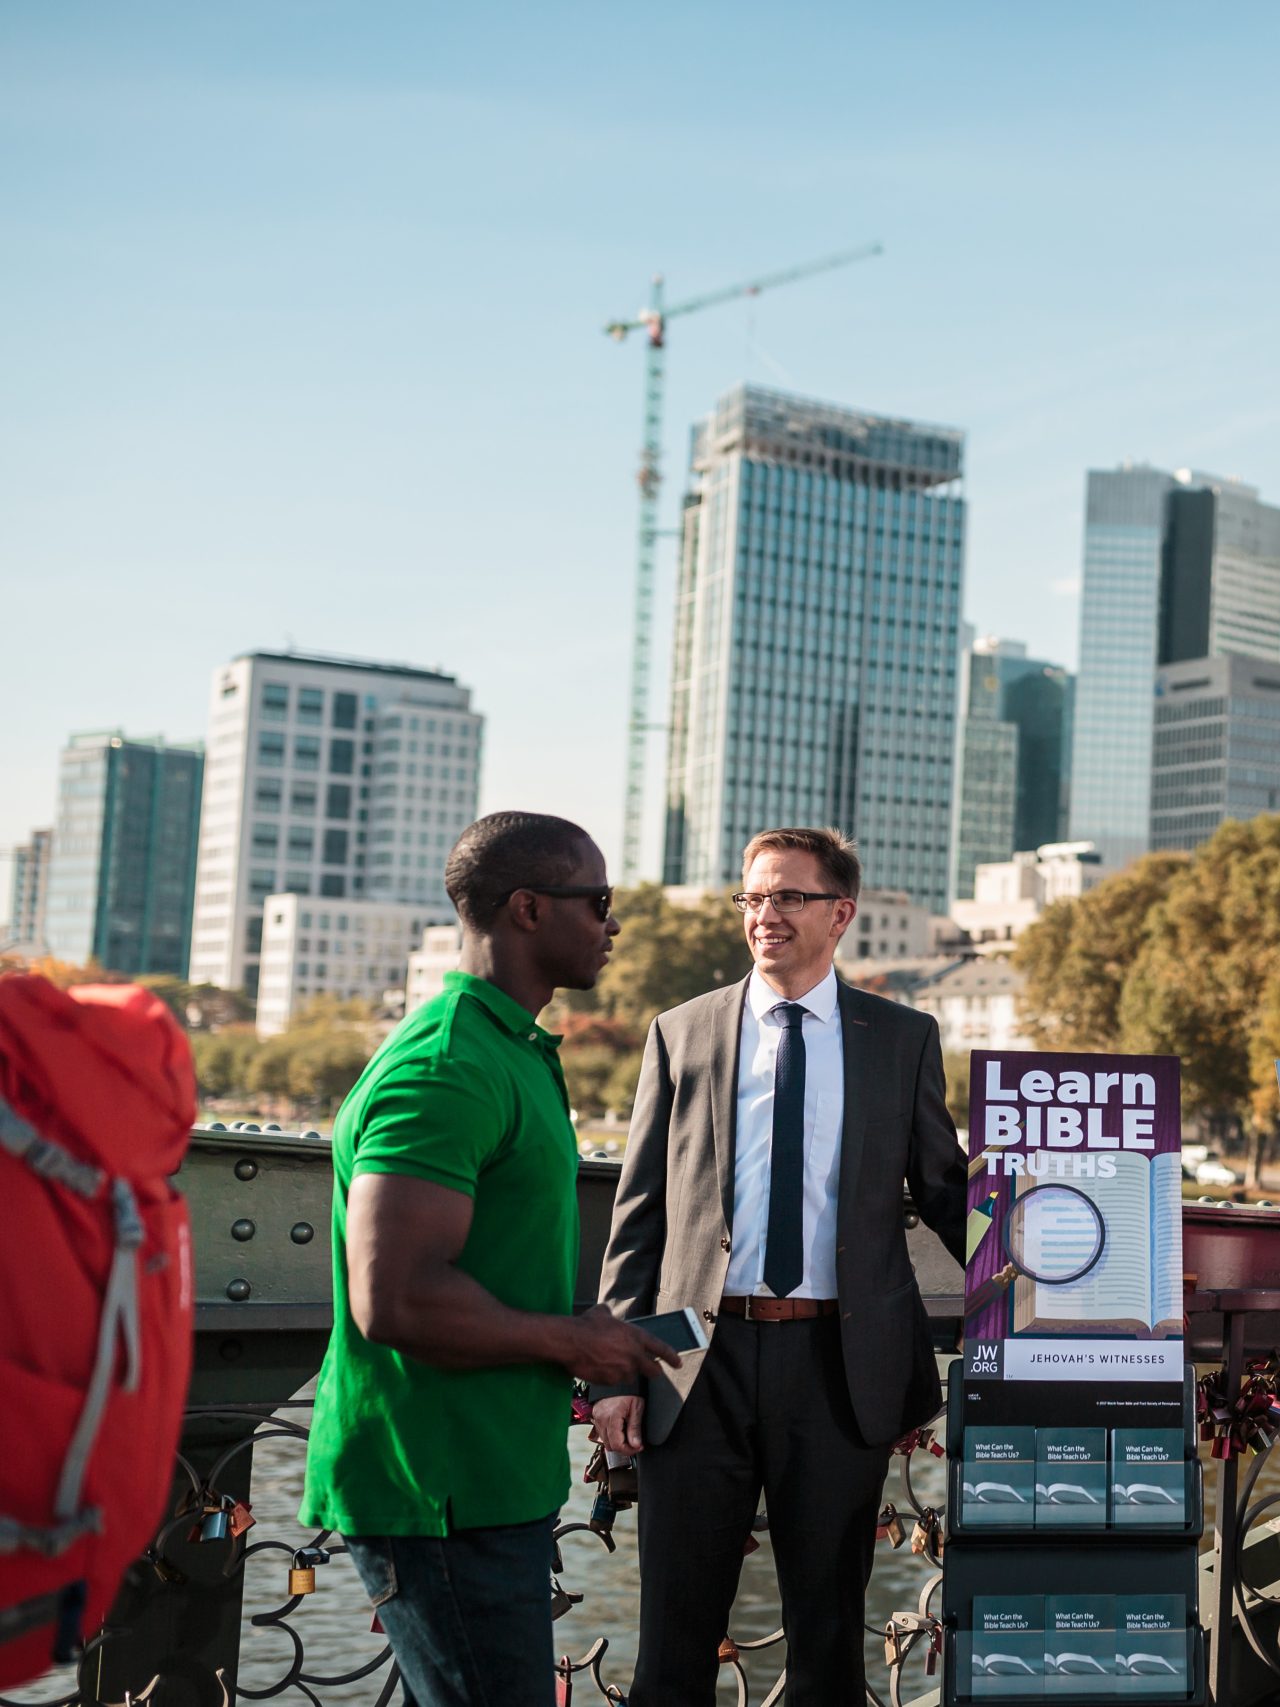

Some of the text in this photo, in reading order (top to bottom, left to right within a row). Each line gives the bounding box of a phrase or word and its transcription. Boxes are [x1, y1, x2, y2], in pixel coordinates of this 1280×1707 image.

[985, 1060, 1156, 1105] Learn
[985, 1106, 1156, 1150] BIBLE
[982, 1152, 1117, 1178] TRUTHS
[973, 1345, 998, 1361] JW
[1030, 1352, 1166, 1364] JEHOVAH'S WITNESSES
[970, 1361, 998, 1374] .ORG
